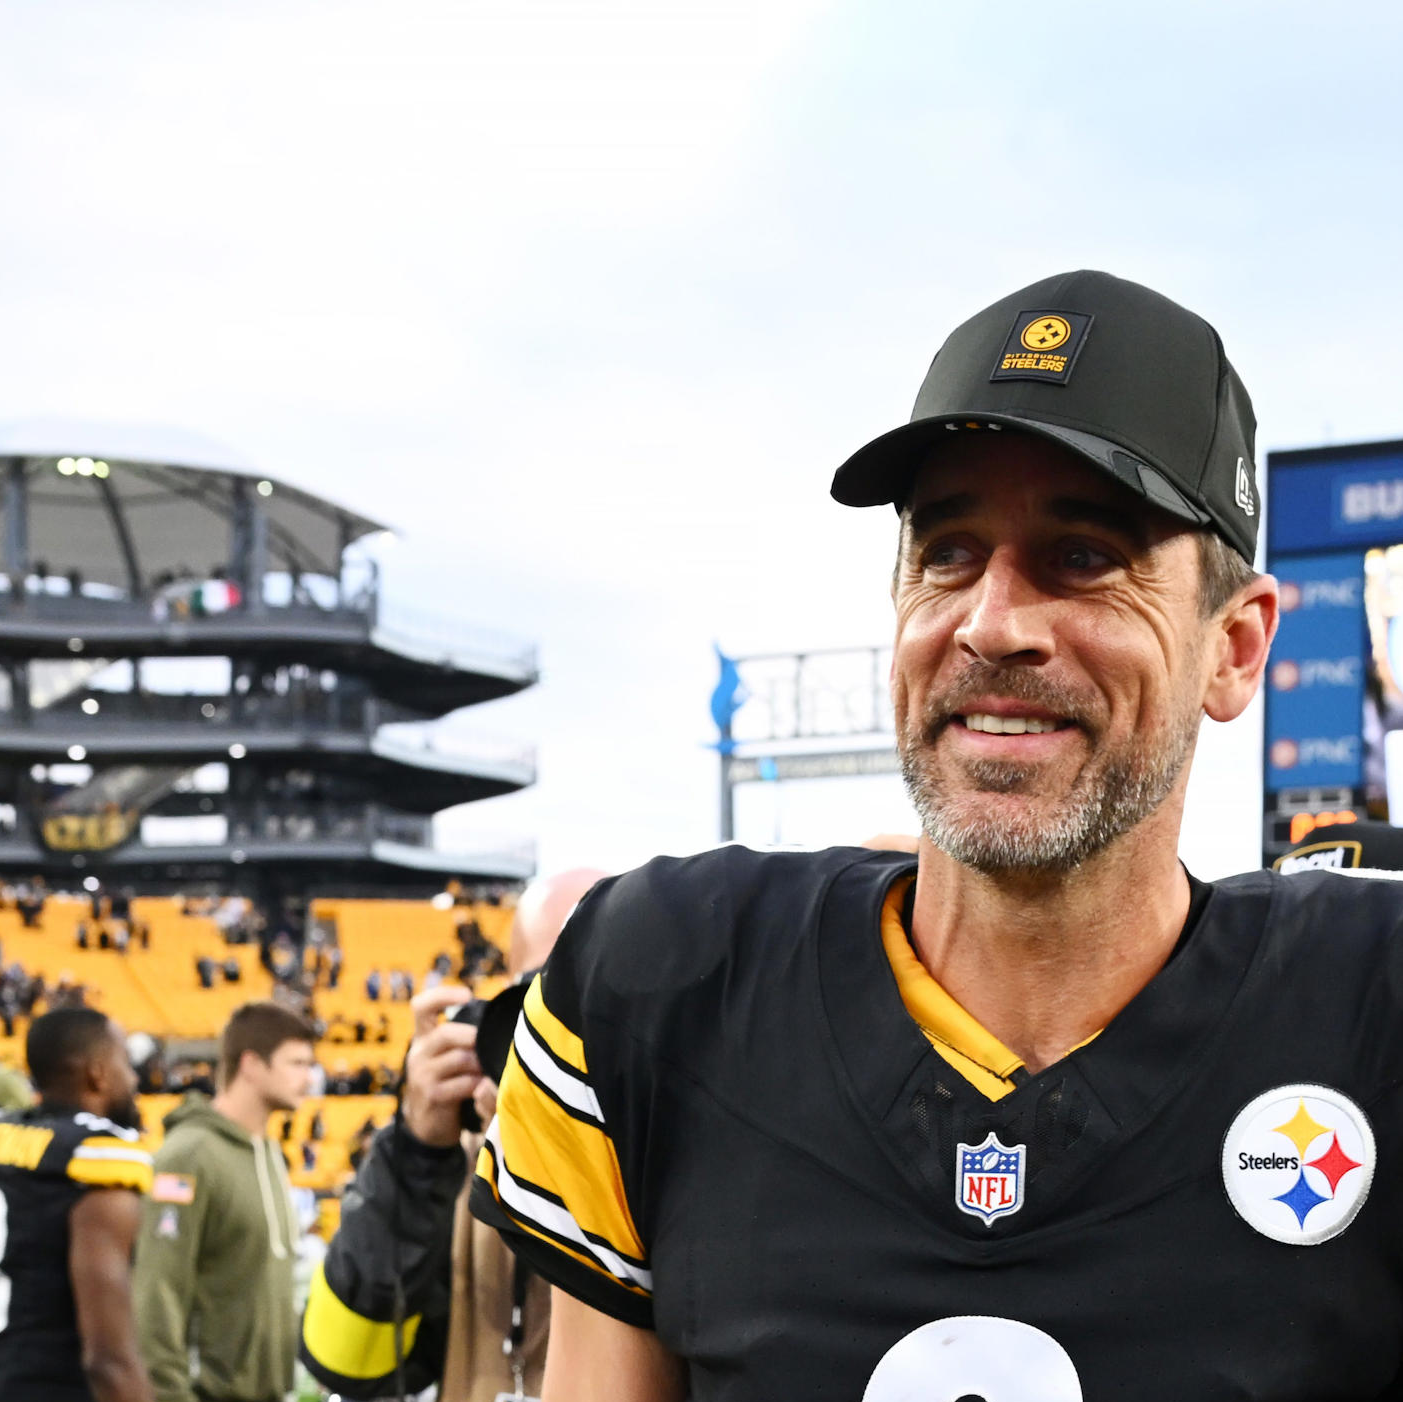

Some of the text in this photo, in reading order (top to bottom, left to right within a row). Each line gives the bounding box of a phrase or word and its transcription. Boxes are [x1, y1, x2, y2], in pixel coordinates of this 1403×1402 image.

[1001, 359, 1065, 372] STEELERS
[1005, 353, 1068, 362] PITTSBURGH
[1301, 577, 1364, 611] PNC
[1299, 656, 1362, 690] PNC
[1238, 1152, 1299, 1171] Steelers
[966, 1176, 1013, 1209] NFL
